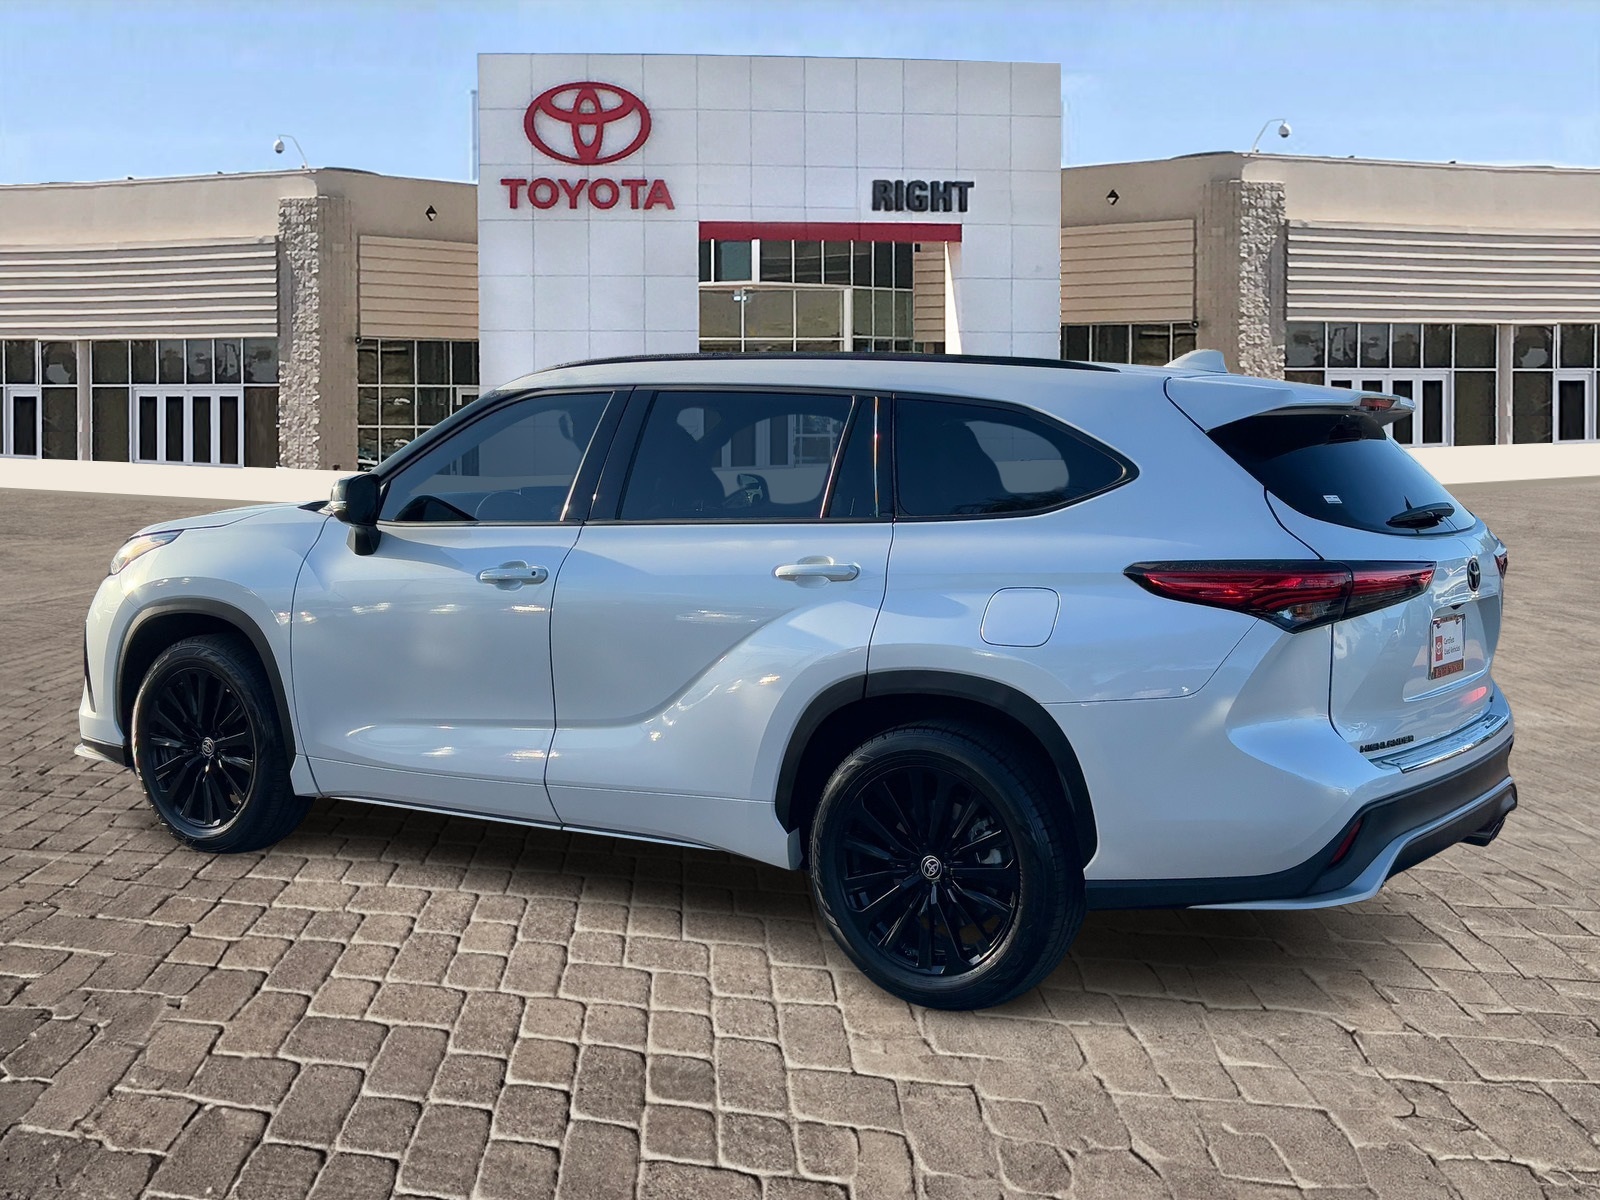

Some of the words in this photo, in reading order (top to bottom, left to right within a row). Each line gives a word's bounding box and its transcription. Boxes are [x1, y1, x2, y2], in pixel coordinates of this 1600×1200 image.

[501, 179, 675, 210] TOYOTA
[872, 180, 975, 213] RIGHT
[1360, 735, 1415, 753] HIGHLANDER
